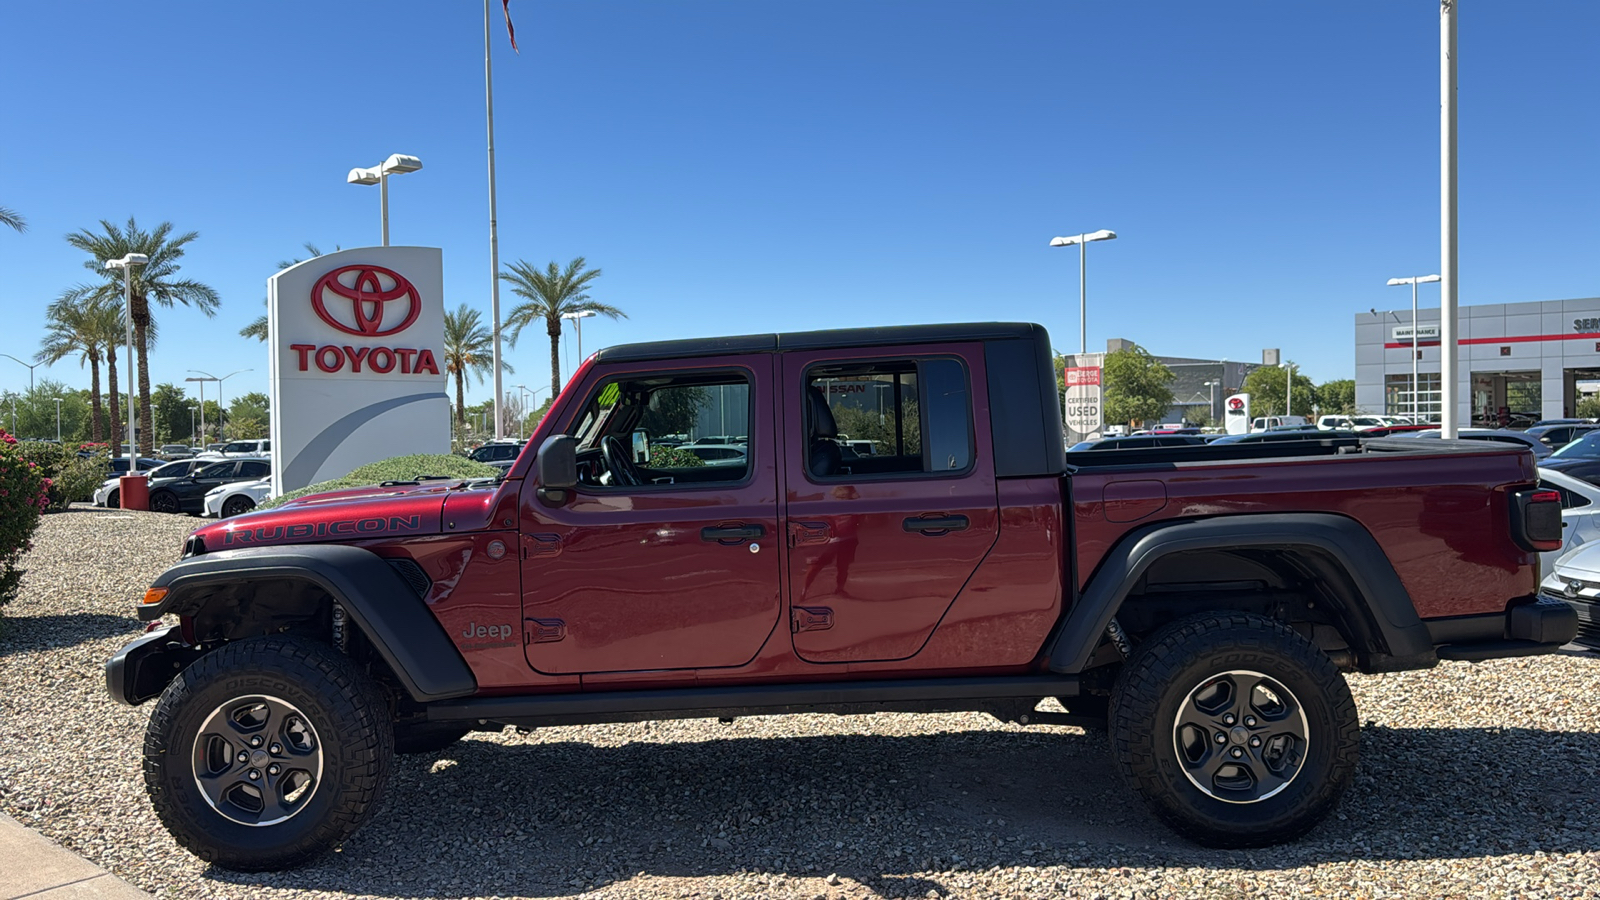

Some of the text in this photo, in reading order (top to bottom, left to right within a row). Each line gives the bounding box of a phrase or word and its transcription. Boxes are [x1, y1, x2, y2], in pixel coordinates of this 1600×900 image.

[1573, 318, 1600, 330] SER
[290, 343, 440, 375] TOYOTA
[816, 385, 865, 393] NSSAN
[1068, 396, 1098, 404] CERTIFIED
[1068, 406, 1098, 417] USED
[223, 514, 421, 545] RUBICON
[462, 622, 512, 640] Jeep
[1210, 653, 1304, 682] COOPER
[225, 677, 335, 742] DISCOVERER
